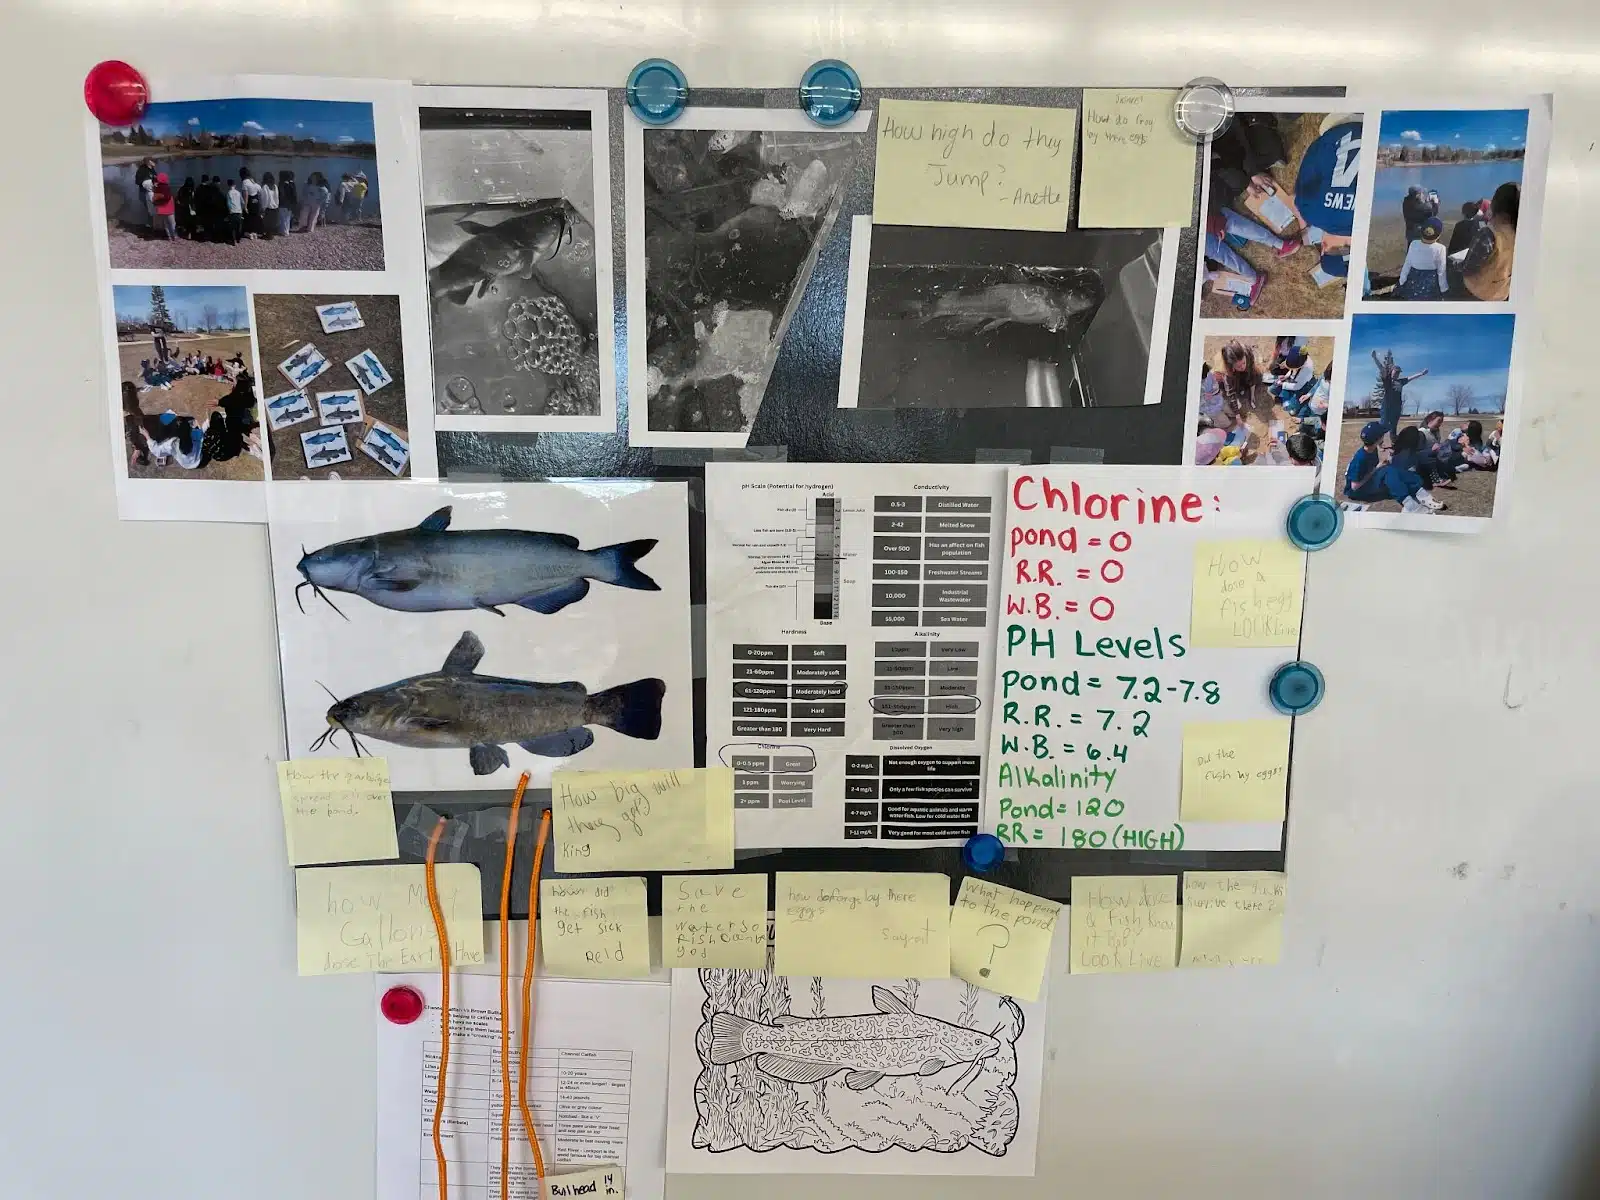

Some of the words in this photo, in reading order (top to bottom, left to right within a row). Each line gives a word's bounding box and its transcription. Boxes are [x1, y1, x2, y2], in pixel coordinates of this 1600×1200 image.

[882, 119, 922, 141] How
[931, 124, 974, 159] high
[983, 120, 1009, 147] do
[1323, 192, 1356, 211] EWS
[1013, 475, 1220, 525] Chlorine:
[1016, 559, 1062, 587] R.R.
[1006, 592, 1060, 620] W.B.
[1006, 624, 1055, 659] PH
[1076, 627, 1186, 660] Levels
[1116, 675, 1221, 705] 7.2-7.8
[1003, 702, 1062, 729] R.R.
[1001, 734, 1055, 760] W.B.
[1086, 744, 1128, 763] 6.4
[999, 762, 1117, 794] Alkalinity
[560, 783, 597, 812] How
[609, 780, 651, 816] big
[652, 770, 681, 796] will
[1076, 798, 1125, 818] 120
[1061, 826, 1107, 849] 180
[1112, 823, 1185, 851] (HIGH)
[677, 880, 745, 901] Save
[966, 881, 1004, 900] What
[960, 896, 976, 909] to
[984, 899, 1010, 921] the
[1013, 915, 1054, 931] pond
[557, 920, 584, 937] get
[976, 923, 1010, 979] ?
[604, 1174, 612, 1184] 14
